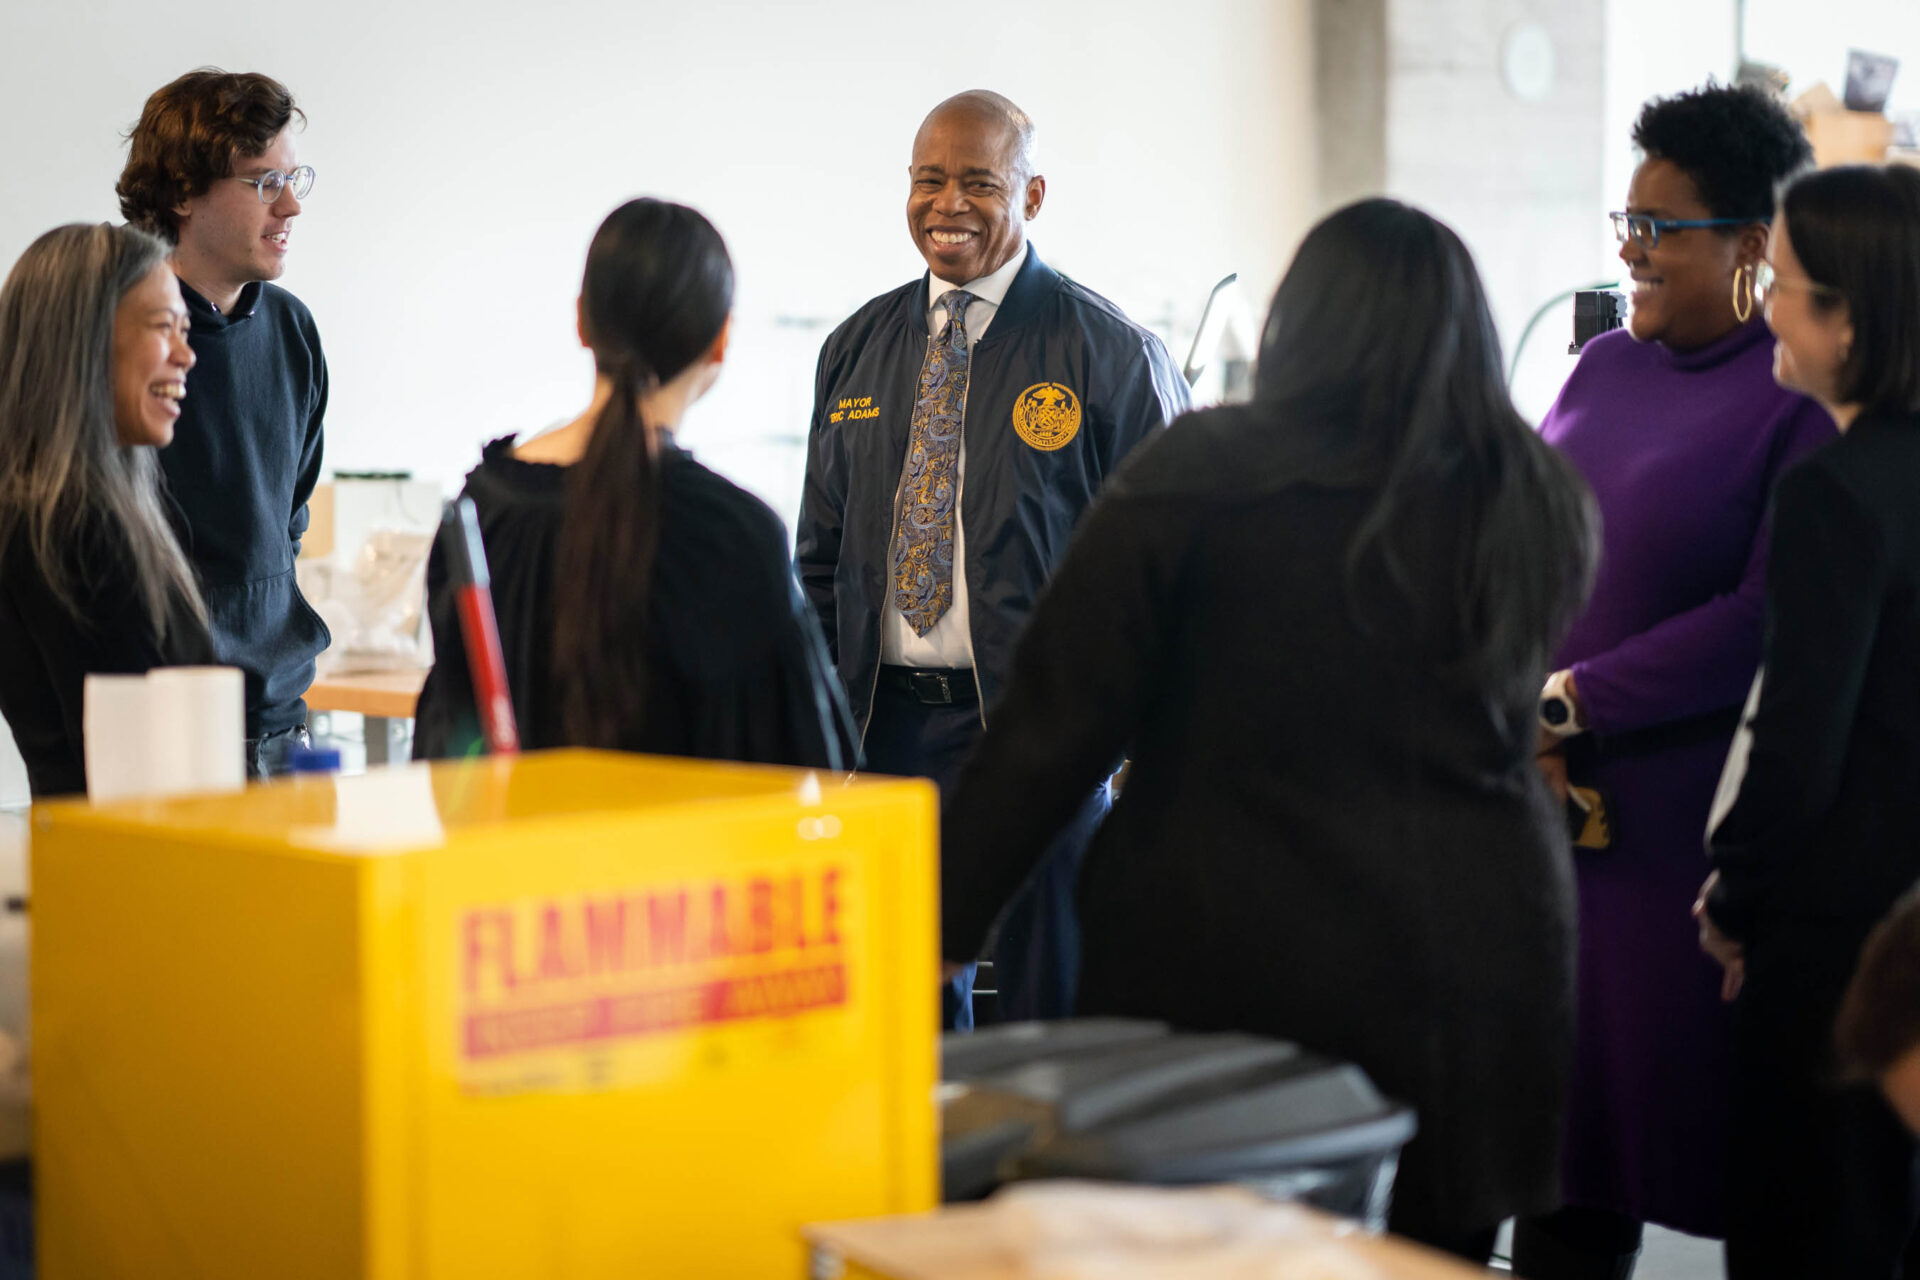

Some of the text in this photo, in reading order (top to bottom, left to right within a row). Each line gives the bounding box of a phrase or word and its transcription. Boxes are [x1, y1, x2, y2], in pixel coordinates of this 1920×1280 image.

[838, 396, 872, 409] MAYOR
[847, 406, 880, 421] ADAMS
[464, 865, 844, 993] FLAMMABLE
